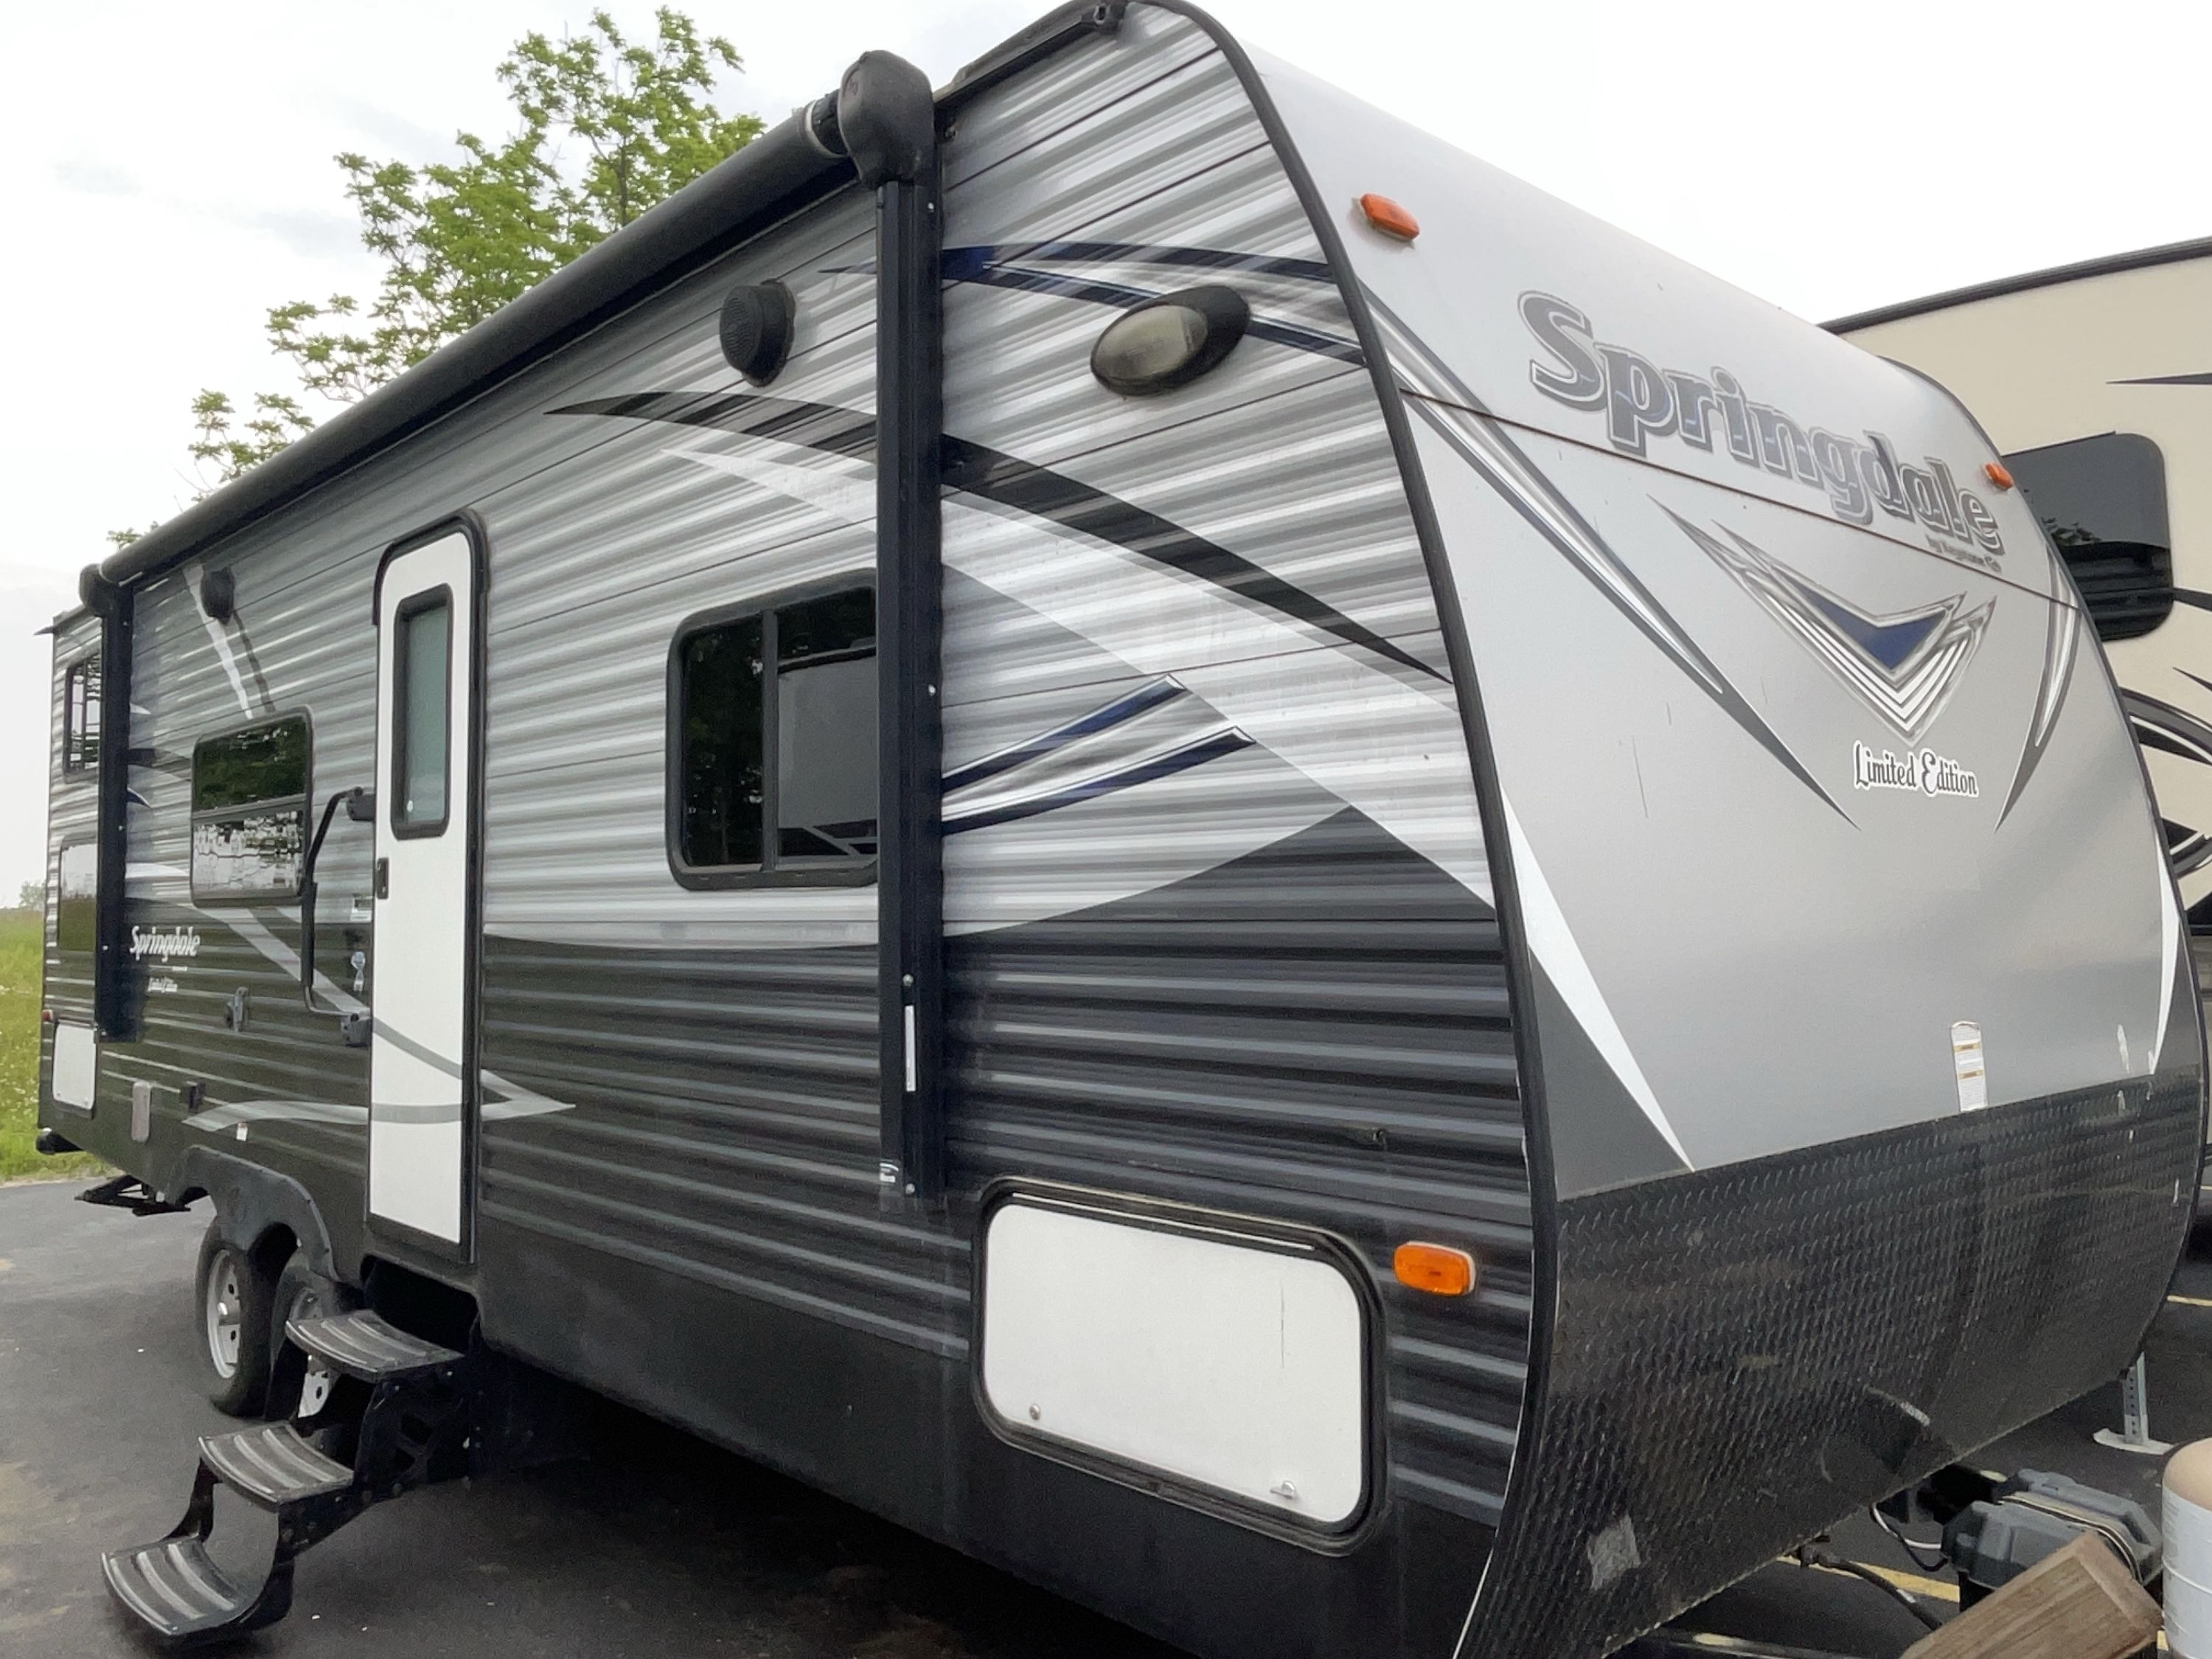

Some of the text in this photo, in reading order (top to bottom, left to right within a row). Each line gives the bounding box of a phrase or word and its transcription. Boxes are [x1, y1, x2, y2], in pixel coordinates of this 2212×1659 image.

[1517, 290, 2006, 556] Springdale
[1854, 742, 1980, 796] Limited Edition
[129, 925, 201, 963] Springdale
